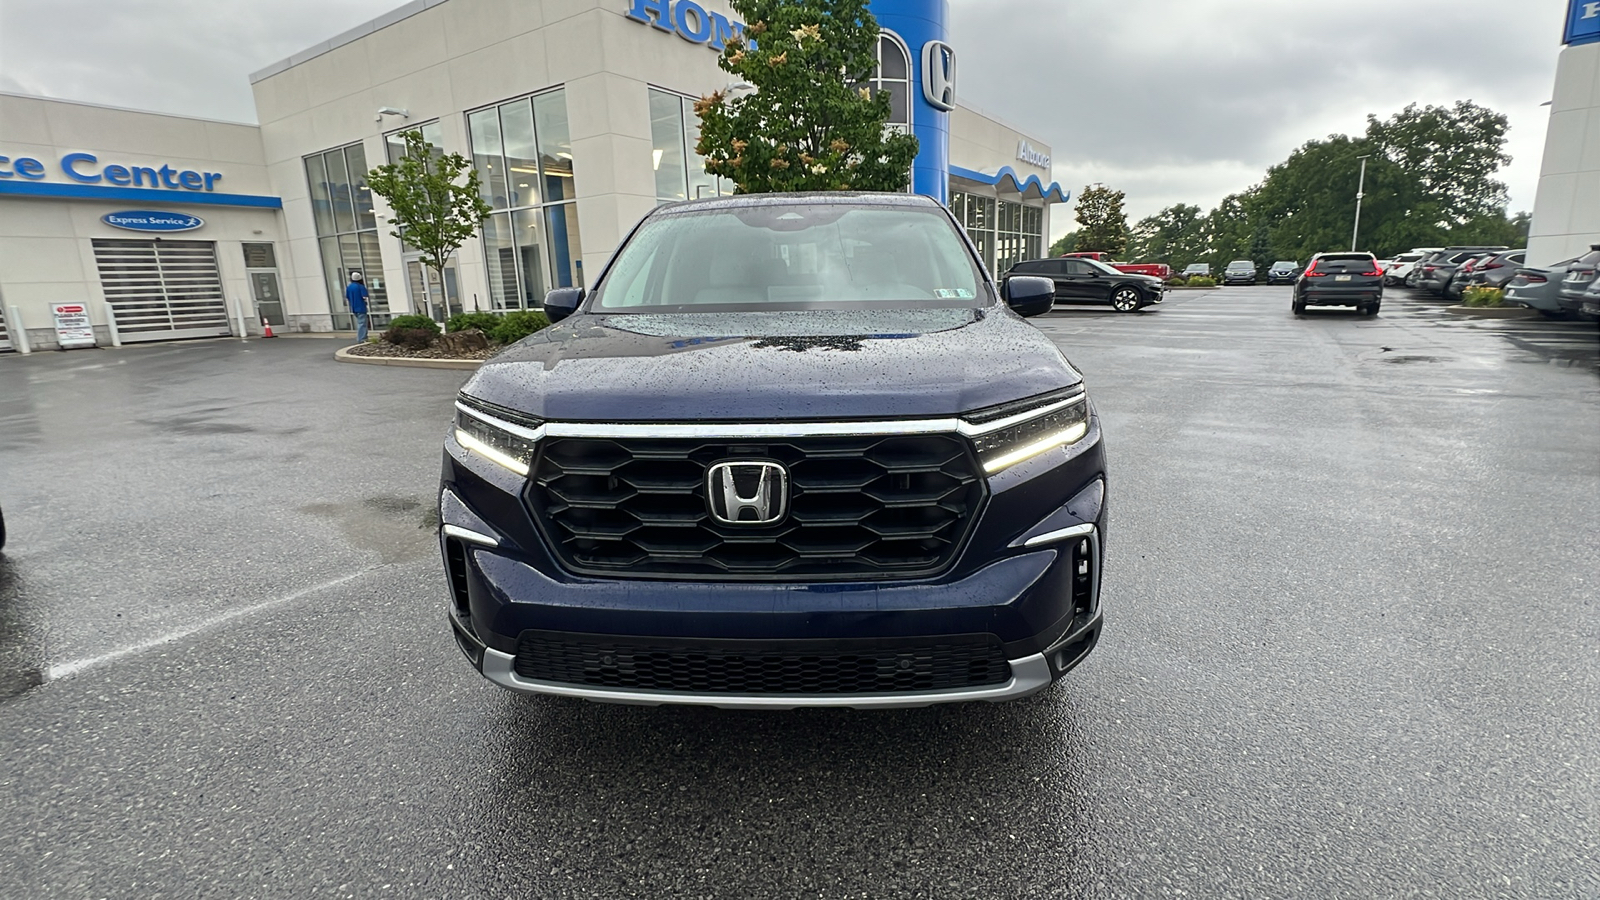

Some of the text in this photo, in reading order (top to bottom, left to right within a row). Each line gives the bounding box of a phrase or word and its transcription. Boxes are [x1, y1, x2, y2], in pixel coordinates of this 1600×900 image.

[625, 0, 759, 51] HON
[60, 152, 222, 191] Center
[108, 215, 184, 225] Express Service
